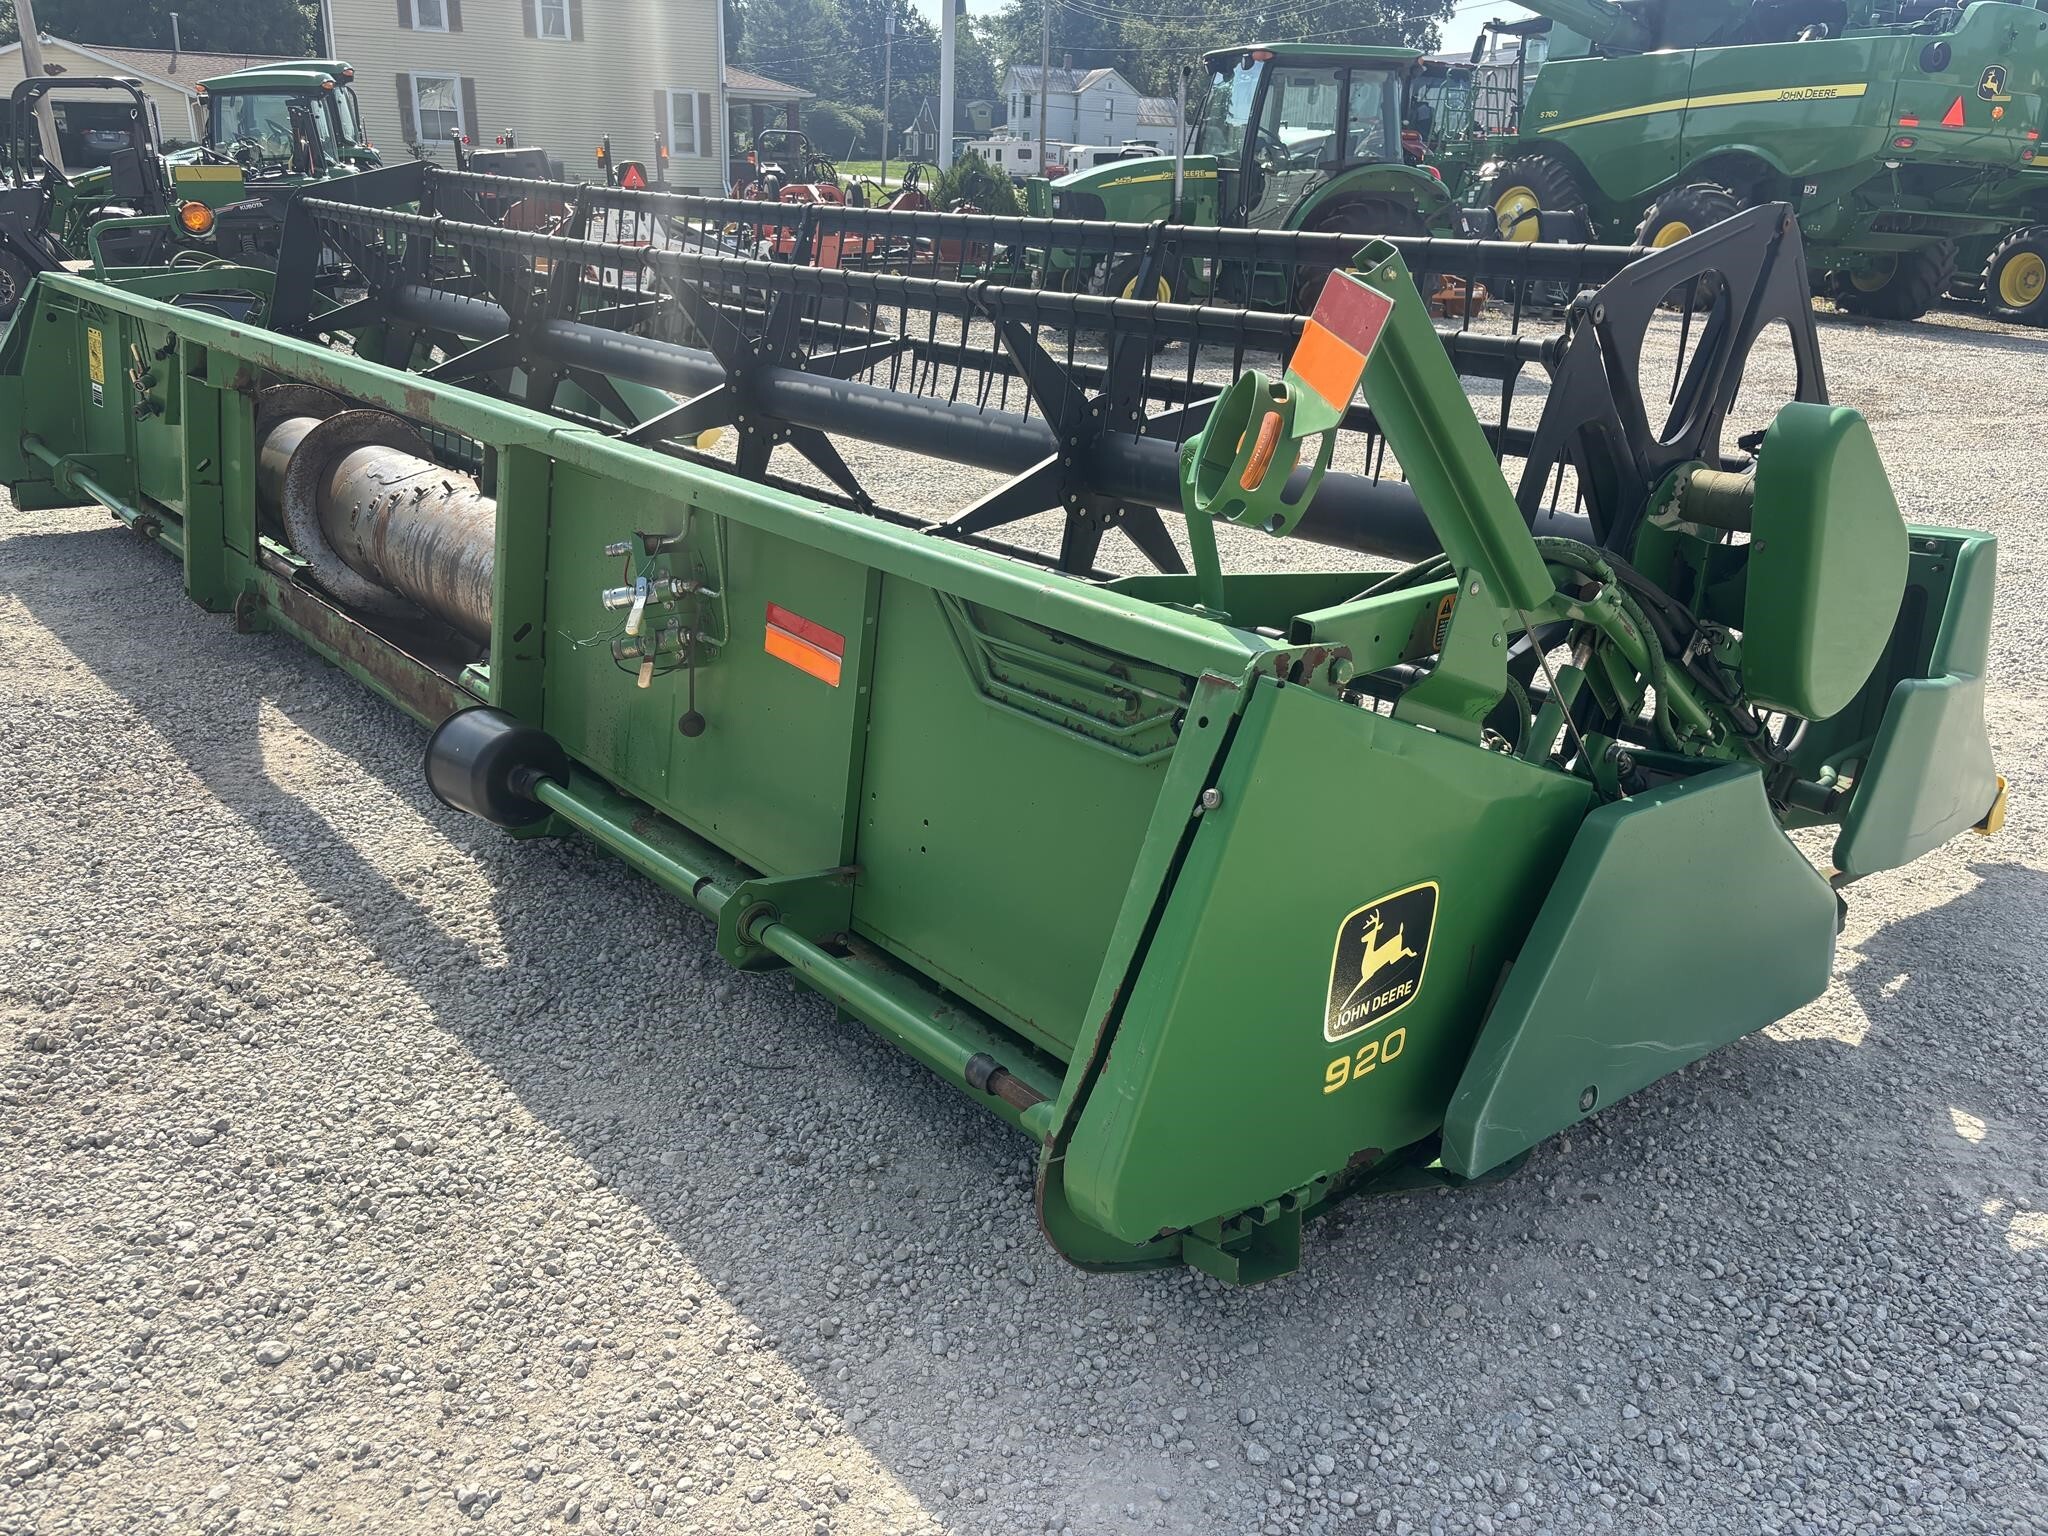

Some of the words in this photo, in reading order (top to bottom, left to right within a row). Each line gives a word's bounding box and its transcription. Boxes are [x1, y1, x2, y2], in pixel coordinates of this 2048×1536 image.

[1777, 90, 1804, 100] JOHN
[1804, 88, 1838, 98] DEERE
[239, 202, 264, 211] KUBOTA
[1333, 1001, 1370, 1030] JOHN
[1371, 979, 1413, 1012] DEERE
[1323, 1027, 1406, 1094] 920
